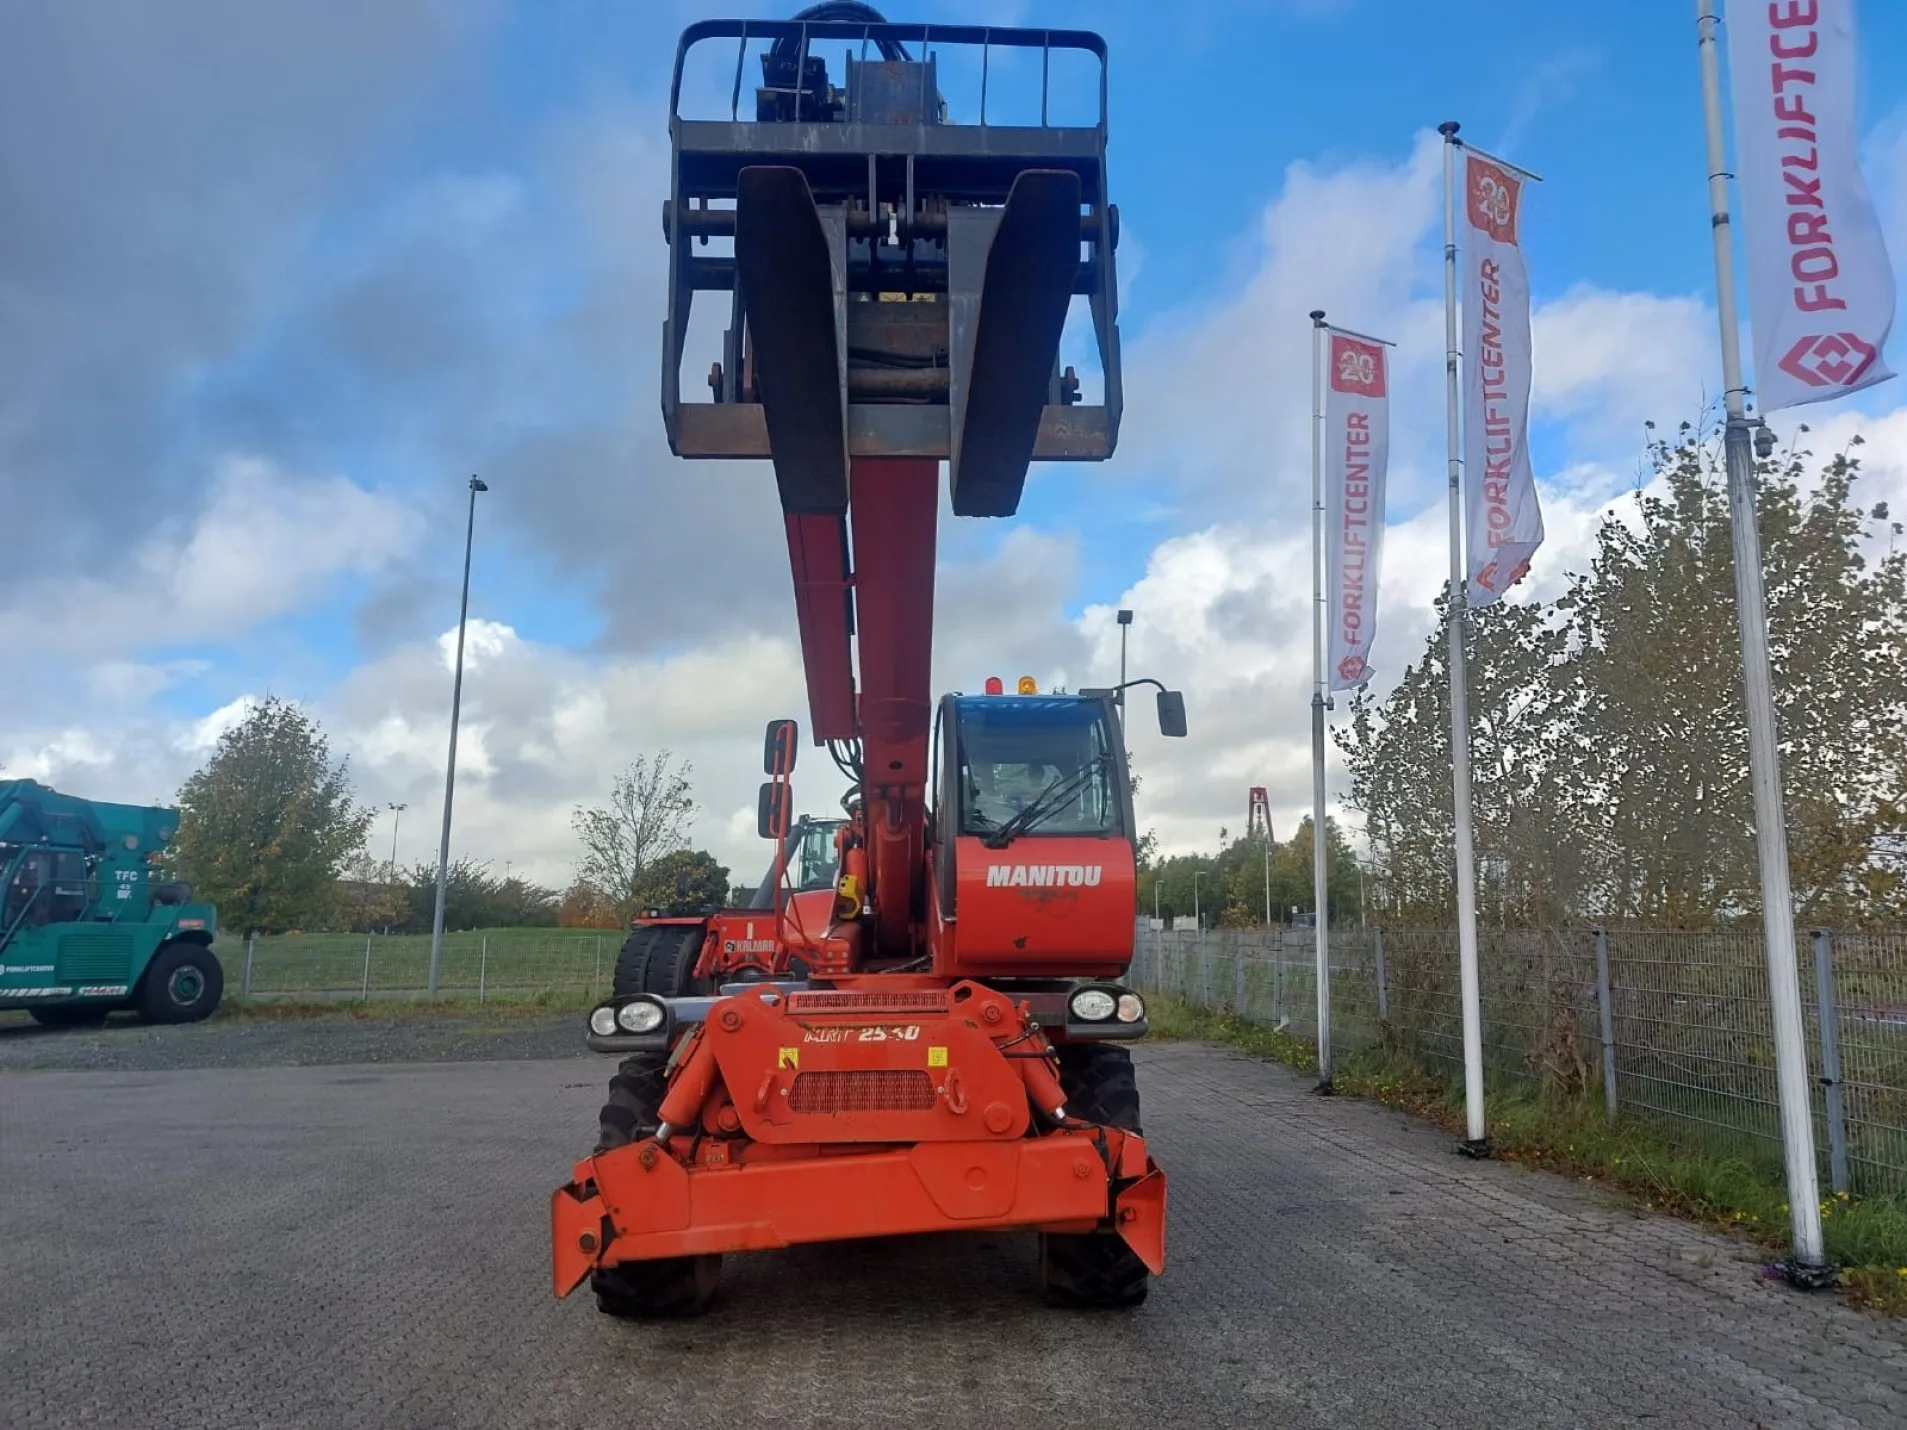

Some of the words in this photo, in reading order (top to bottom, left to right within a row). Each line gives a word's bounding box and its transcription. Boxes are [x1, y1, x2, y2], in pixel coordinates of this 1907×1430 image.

[1481, 258, 1516, 548] FORKLIFTCENTER
[1343, 412, 1370, 645] FORKLIFTCENTER
[115, 870, 138, 881] TFC
[986, 865, 1102, 887] MANITOU
